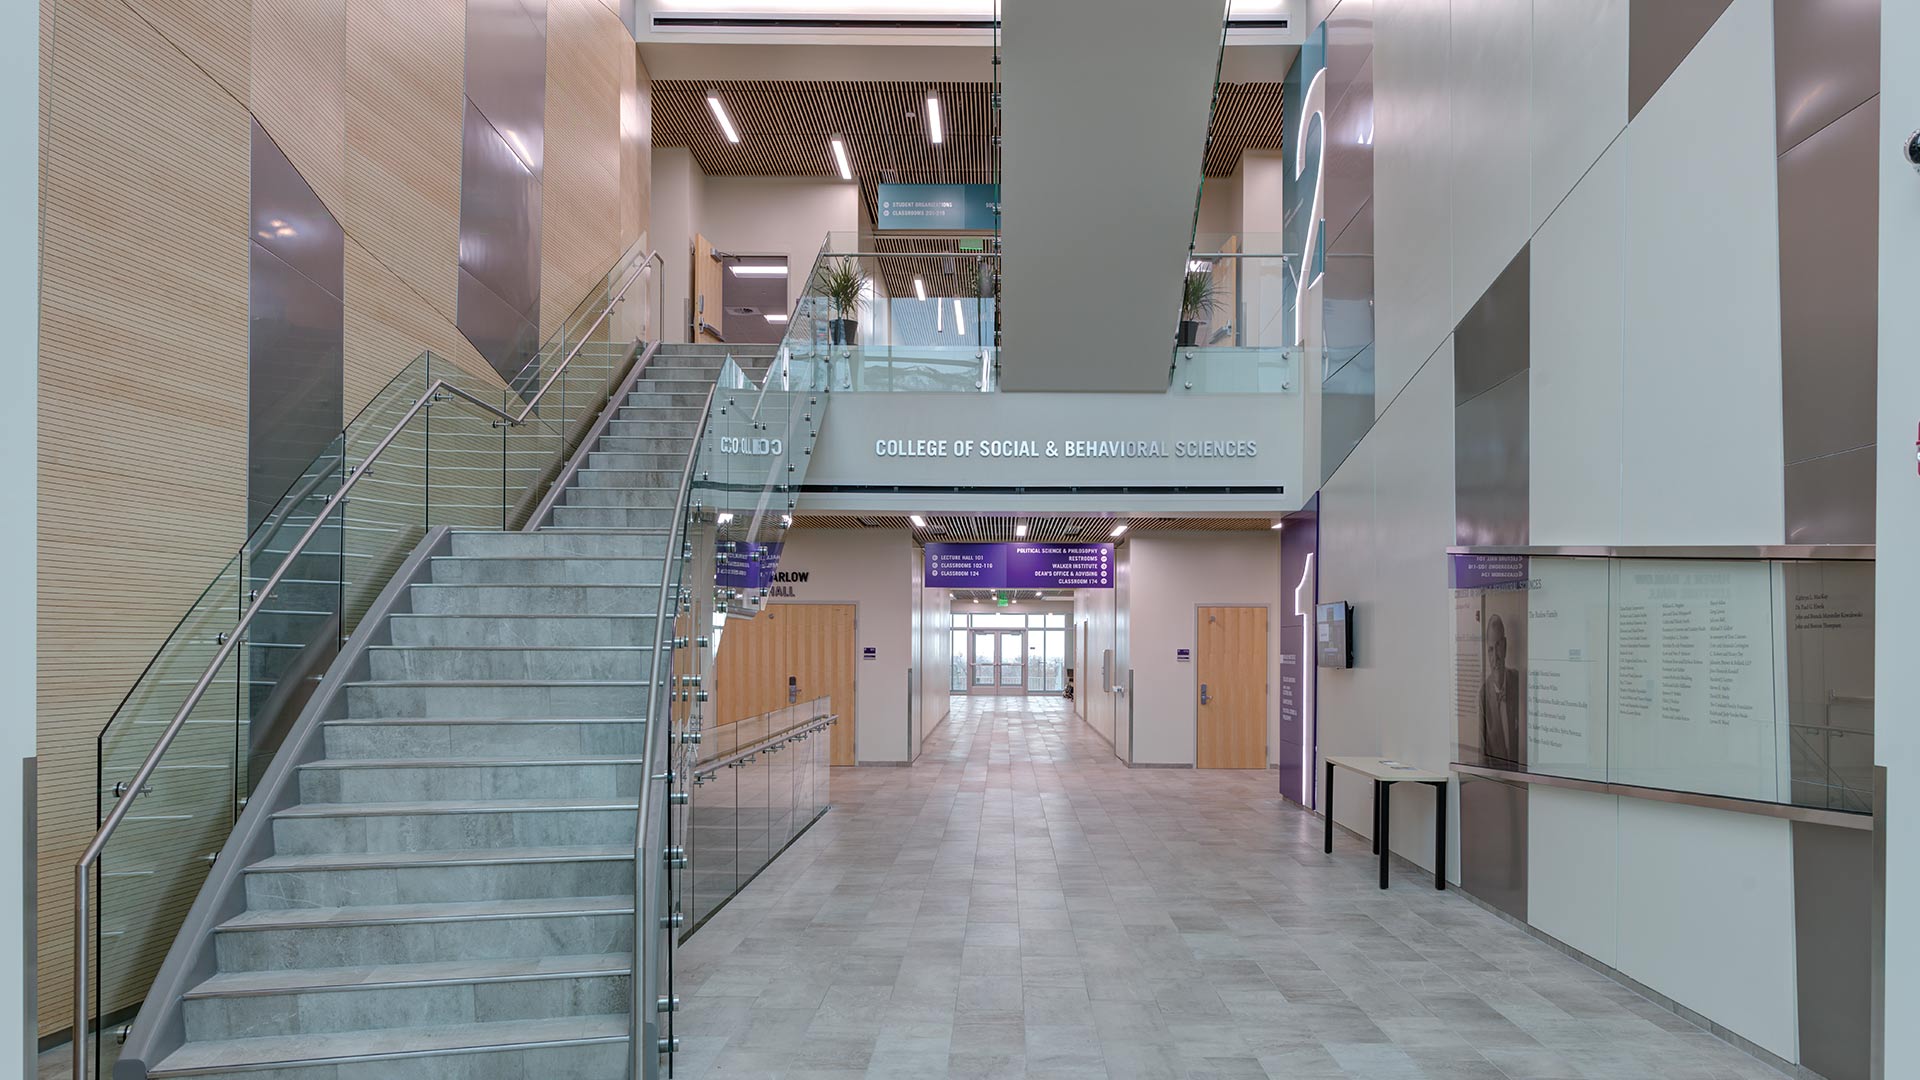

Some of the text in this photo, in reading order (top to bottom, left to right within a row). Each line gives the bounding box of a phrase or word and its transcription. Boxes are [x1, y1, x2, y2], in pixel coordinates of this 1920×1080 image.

[875, 439, 1258, 458] COLLEGE OF SOCIAL & BEHAVIORAL SCIENCES
[768, 571, 810, 583] ARLOW
